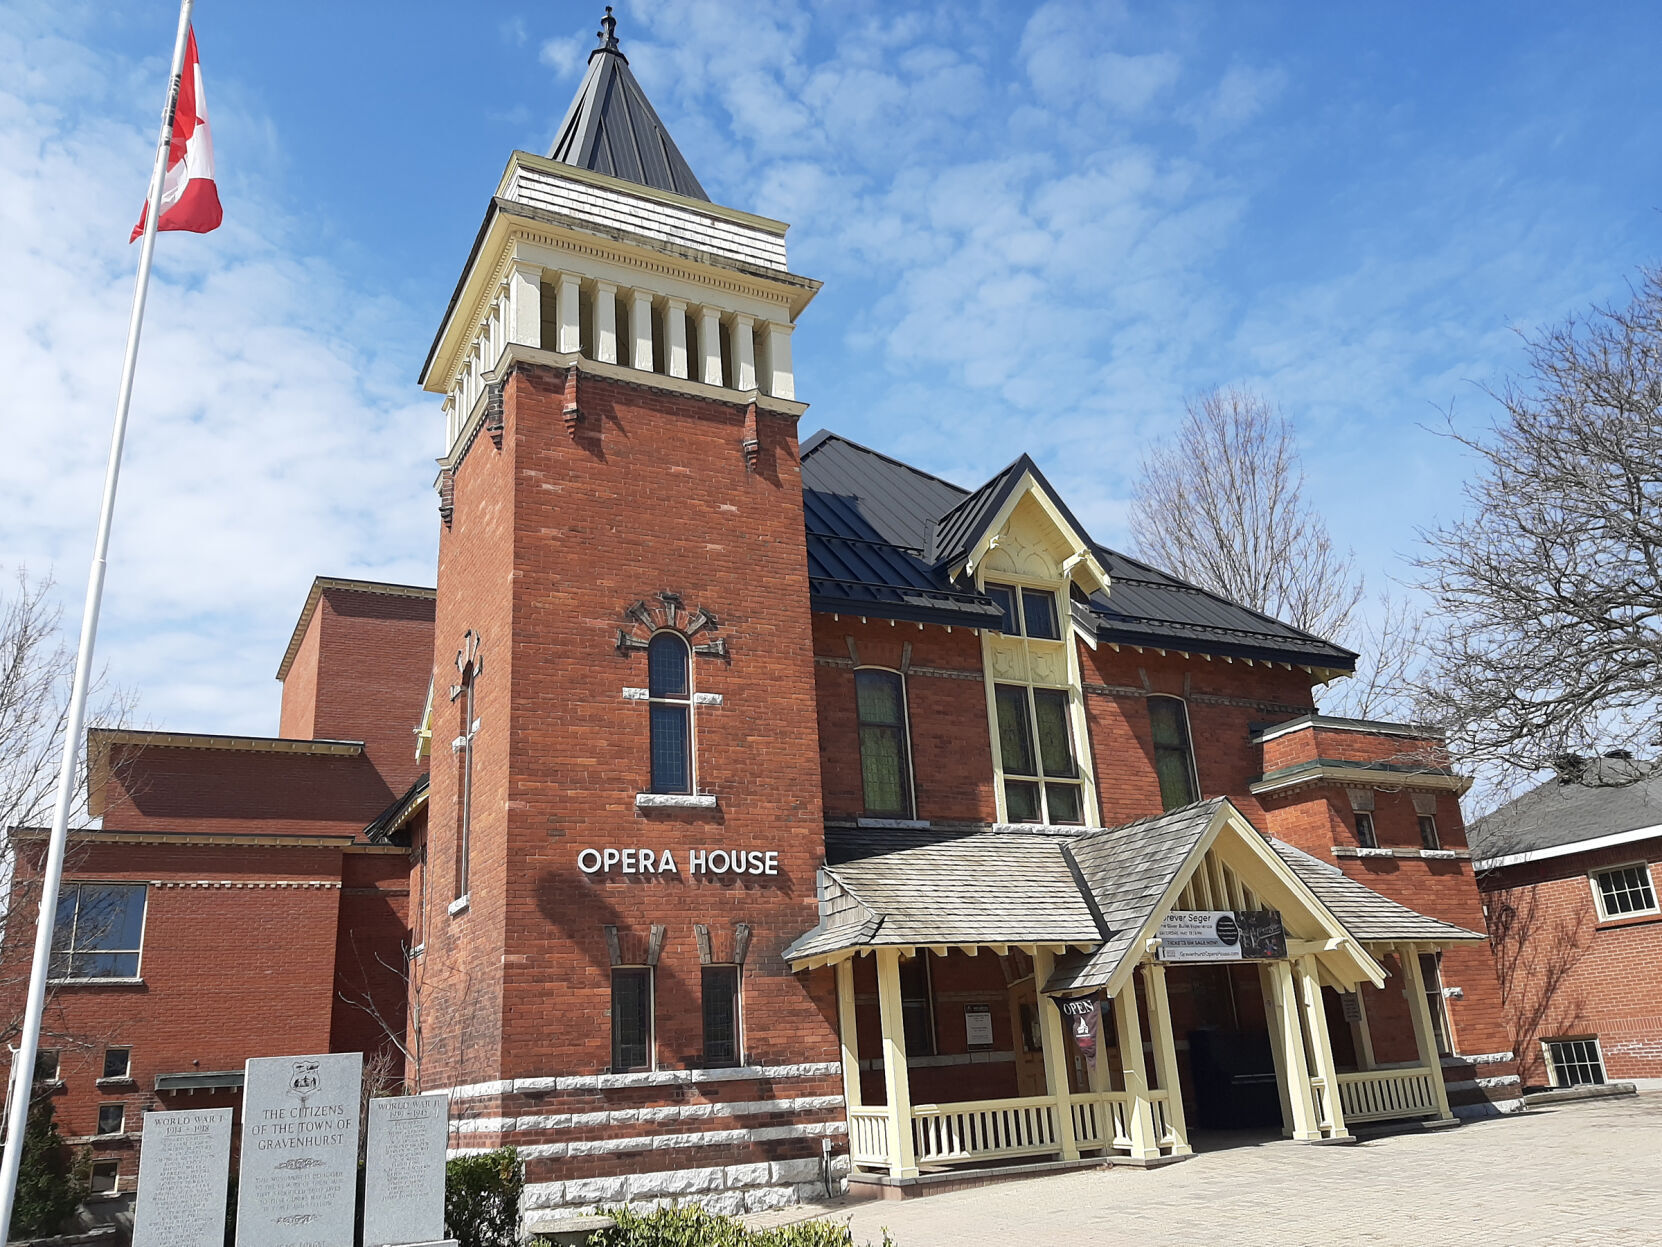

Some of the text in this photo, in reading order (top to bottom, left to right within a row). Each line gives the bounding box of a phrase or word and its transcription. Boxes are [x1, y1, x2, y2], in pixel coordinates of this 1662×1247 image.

[577, 848, 779, 875] OPERA HOUSE
[1163, 913, 1211, 924] rever Seger
[1063, 1000, 1094, 1015] OPEN
[263, 1104, 344, 1120] THE CITIZENS
[378, 1102, 409, 1110] WORLD
[412, 1100, 430, 1108] WAR
[154, 1118, 191, 1126] WORLD
[194, 1115, 215, 1124] WAR
[251, 1118, 351, 1136] OF THE TOWN OF
[194, 1124, 210, 1133] 1918
[258, 1134, 344, 1150] GRAVENHURST
